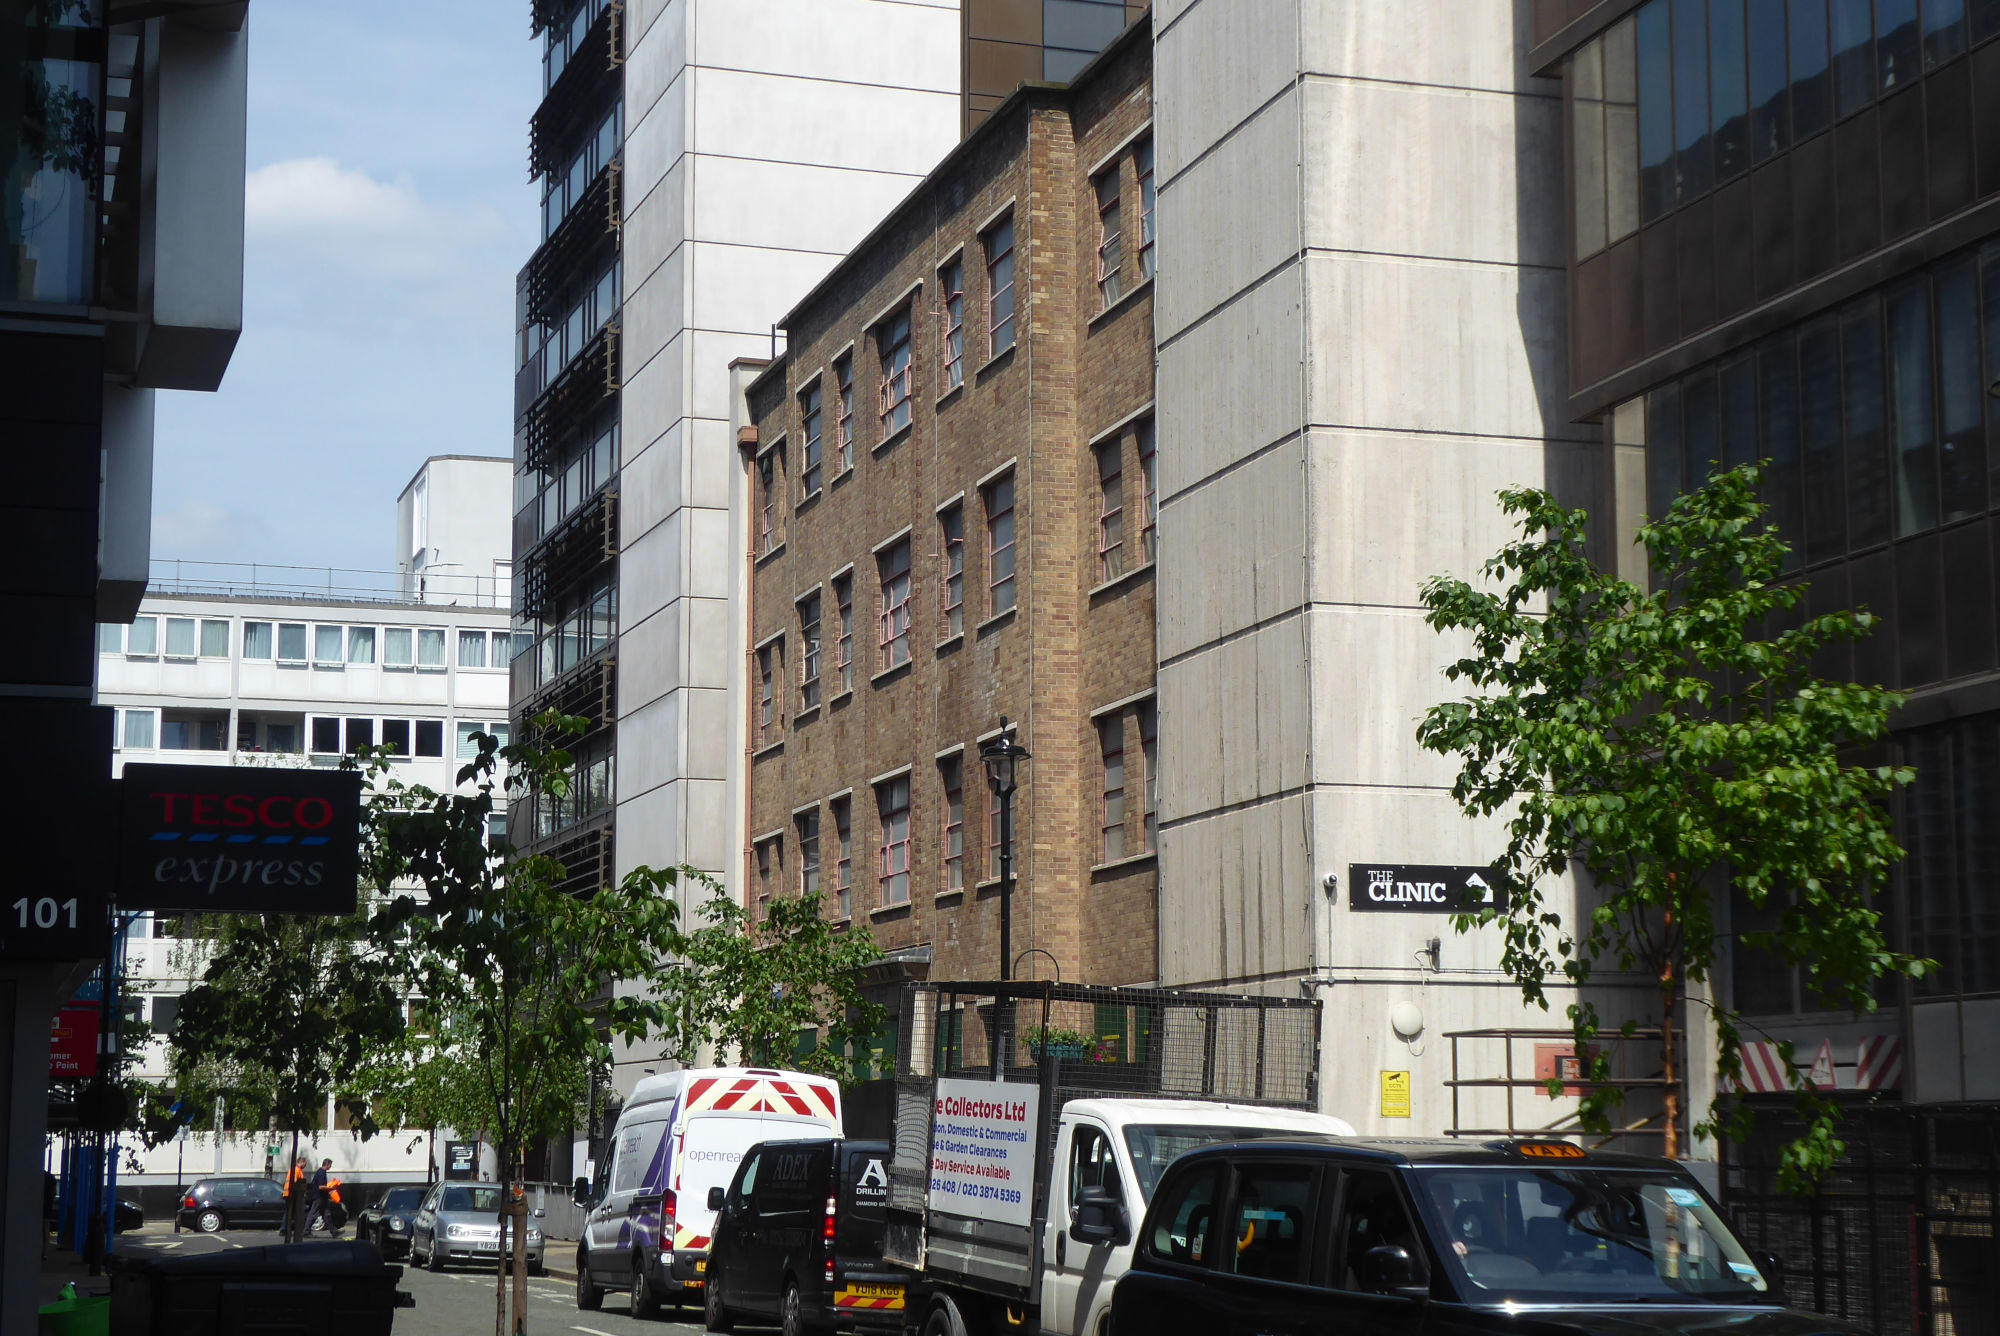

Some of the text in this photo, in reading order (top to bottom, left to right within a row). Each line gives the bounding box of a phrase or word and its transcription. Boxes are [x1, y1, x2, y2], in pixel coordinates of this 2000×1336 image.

[150, 793, 334, 829] TESCO
[154, 854, 324, 895] express
[1368, 871, 1393, 882] THE
[1368, 882, 1446, 903] CLINIC
[12, 897, 77, 928] 101
[56, 1061, 79, 1069] Point
[945, 1097, 1002, 1120] Collectors
[1005, 1101, 1026, 1122] Ltd
[947, 1123, 979, 1139] Domestic
[980, 1127, 984, 1139] &
[985, 1128, 1027, 1143] Commercial
[940, 1140, 945, 1151] &
[945, 1140, 969, 1154] Garden
[969, 1144, 1007, 1159] Clearances
[1525, 1145, 1581, 1157] TAXI
[772, 1153, 812, 1181] ADEX
[935, 1158, 947, 1174] Day
[948, 1160, 975, 1175] Service
[976, 1163, 1011, 1180] Available
[856, 1188, 887, 1196] DRILLIN
[941, 1180, 956, 1194] 408
[956, 1181, 962, 1196] /
[962, 1182, 979, 1197] 020
[979, 1185, 999, 1200] 3874
[1000, 1188, 1021, 1203] 5369
